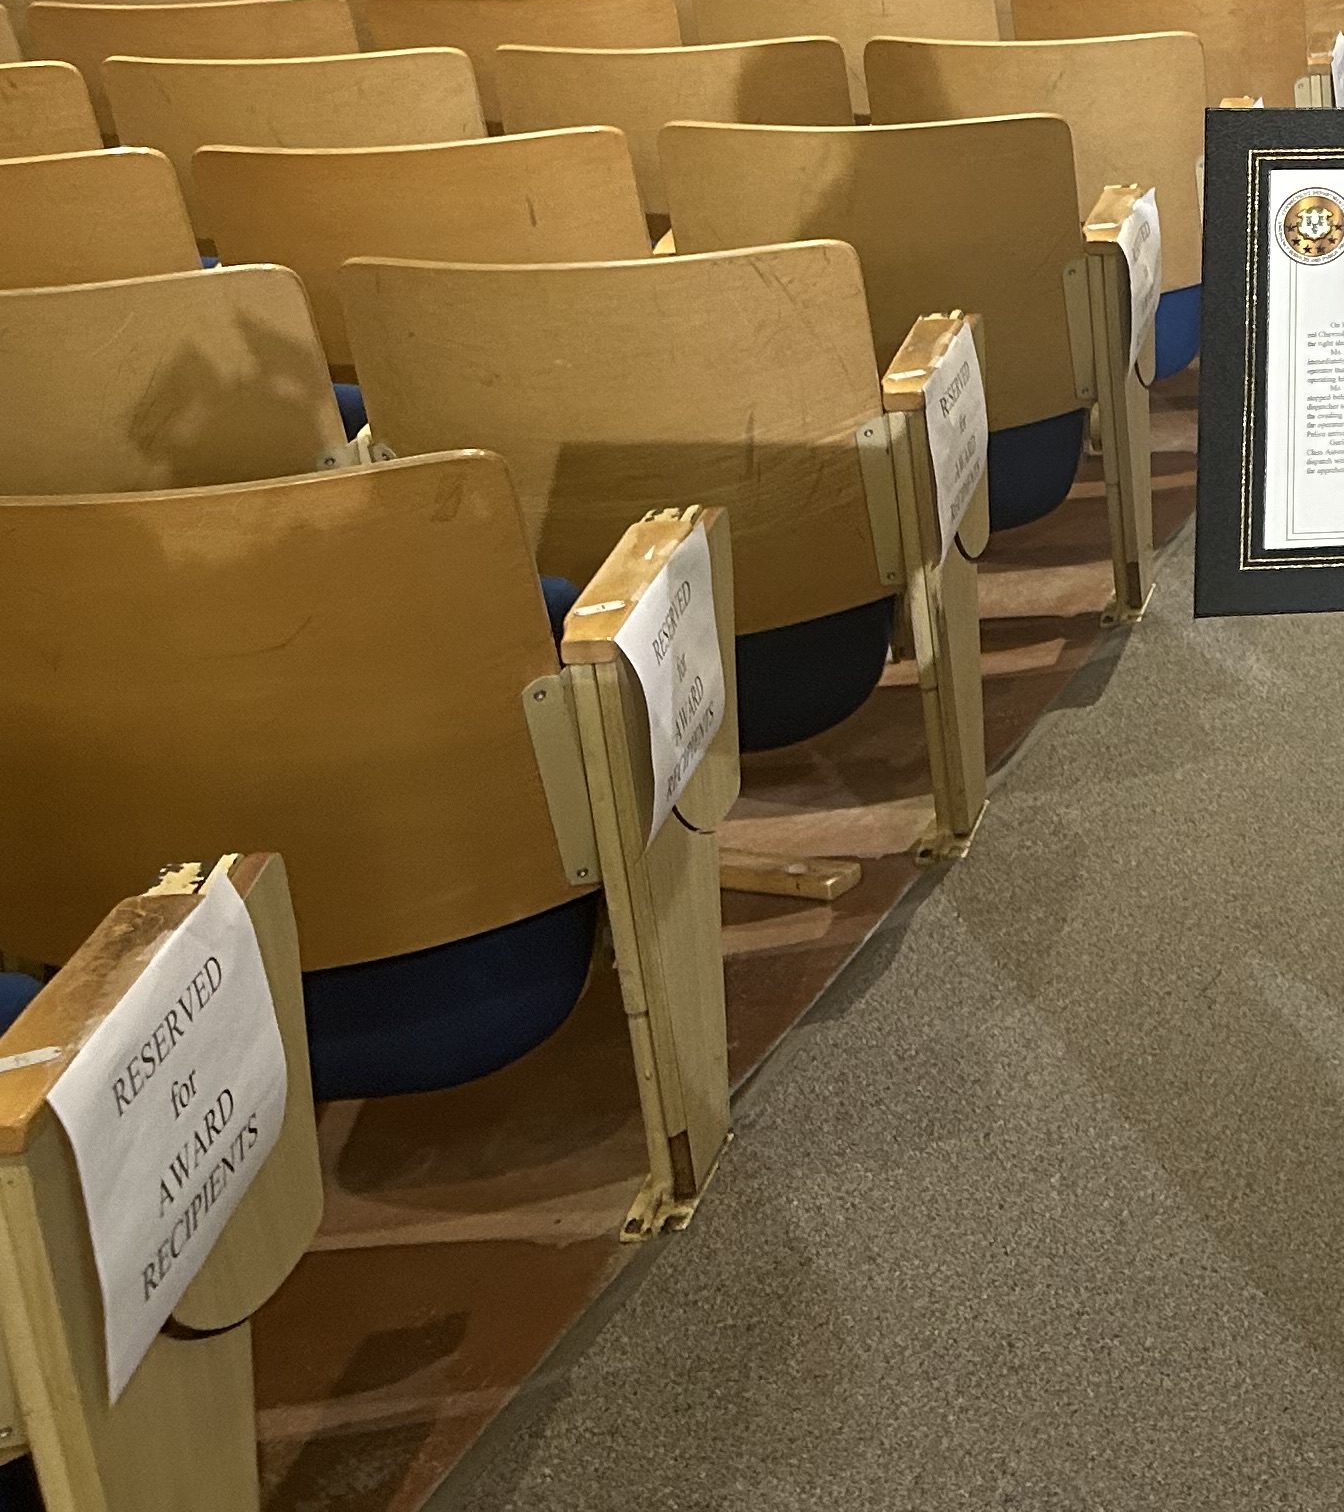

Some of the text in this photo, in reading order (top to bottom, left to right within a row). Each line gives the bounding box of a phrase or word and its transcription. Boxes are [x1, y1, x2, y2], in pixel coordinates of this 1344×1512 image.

[651, 580, 692, 667] RESERVED
[112, 954, 224, 1118] RESERVED
[169, 1067, 199, 1121] for
[141, 1113, 260, 1303] RECIPIENTS
[157, 1086, 236, 1220] AWARD
